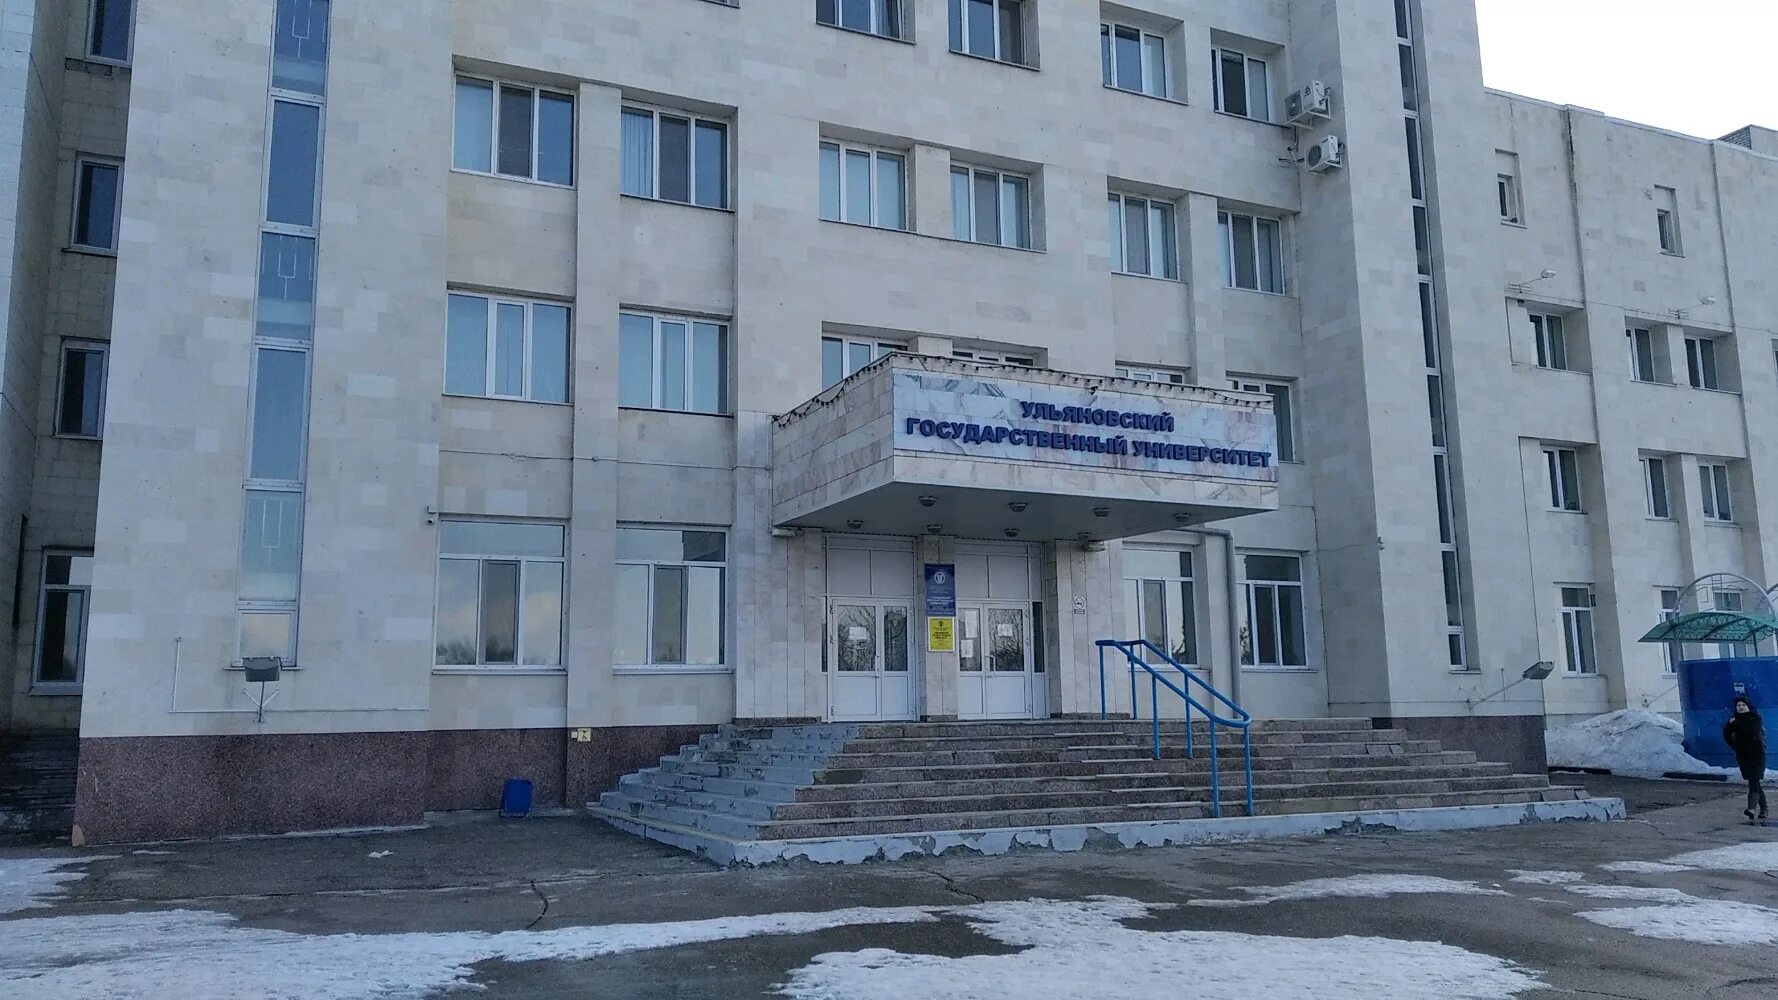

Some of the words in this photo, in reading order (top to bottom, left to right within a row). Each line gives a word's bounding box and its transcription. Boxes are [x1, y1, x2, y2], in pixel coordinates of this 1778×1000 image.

[1021, 401, 1174, 432] УЛЬЯНОВСКИЙ
[906, 418, 1128, 455] ГОСУДАРСТВЕННЫЙ
[1132, 441, 1271, 467] УНИВЕРСИТЕТ
